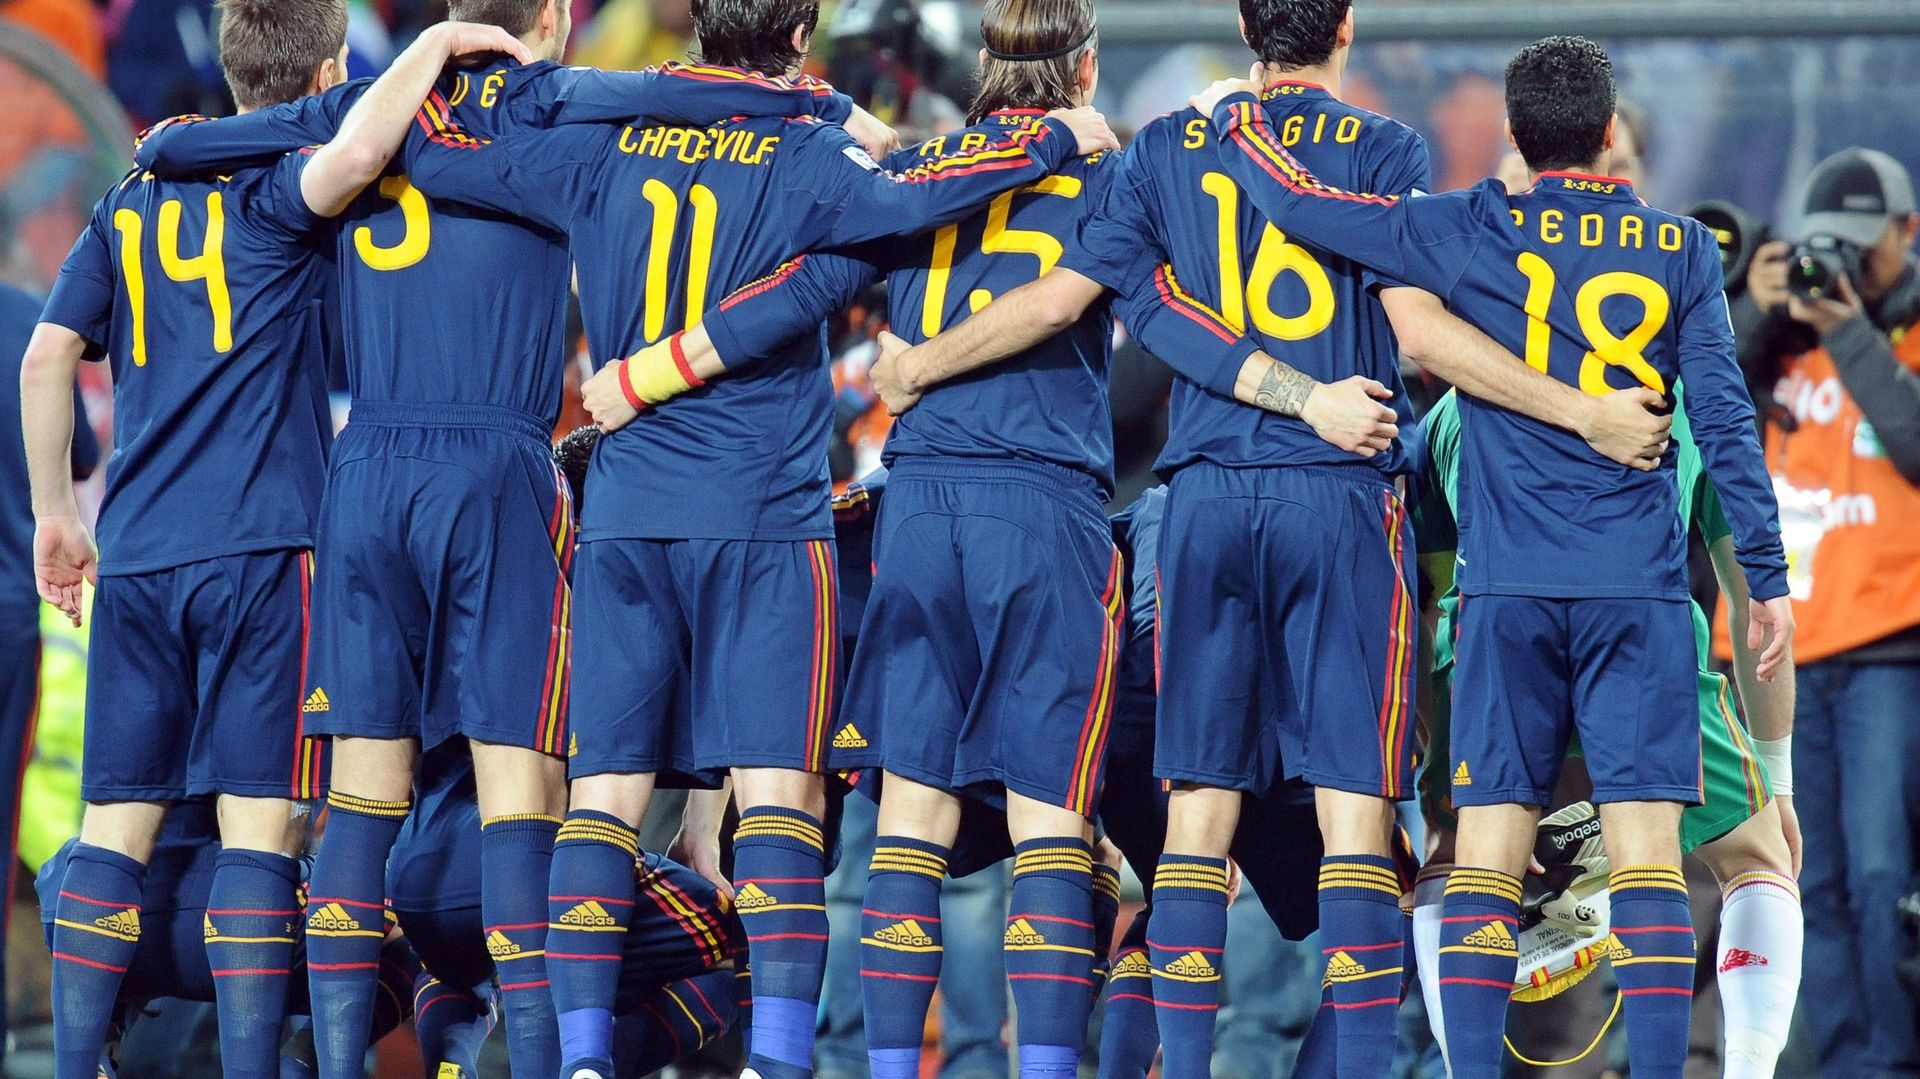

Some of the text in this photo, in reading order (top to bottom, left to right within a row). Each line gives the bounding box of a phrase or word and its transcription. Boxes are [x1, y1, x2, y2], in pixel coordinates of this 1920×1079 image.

[1183, 113, 1362, 149] SGIO
[641, 178, 718, 343] 11
[1201, 172, 1335, 341] 16
[114, 191, 233, 367] 14
[1516, 252, 1669, 395] 18
[302, 703, 330, 712] adida
[833, 739, 868, 748] adidas
[1552, 819, 1600, 849] eebok
[734, 896, 777, 908] adidas
[309, 917, 360, 930] adidas
[559, 914, 616, 926] adidas
[874, 931, 932, 946] adidas
[1461, 935, 1516, 950] adidas
[1165, 963, 1215, 977] adidas
